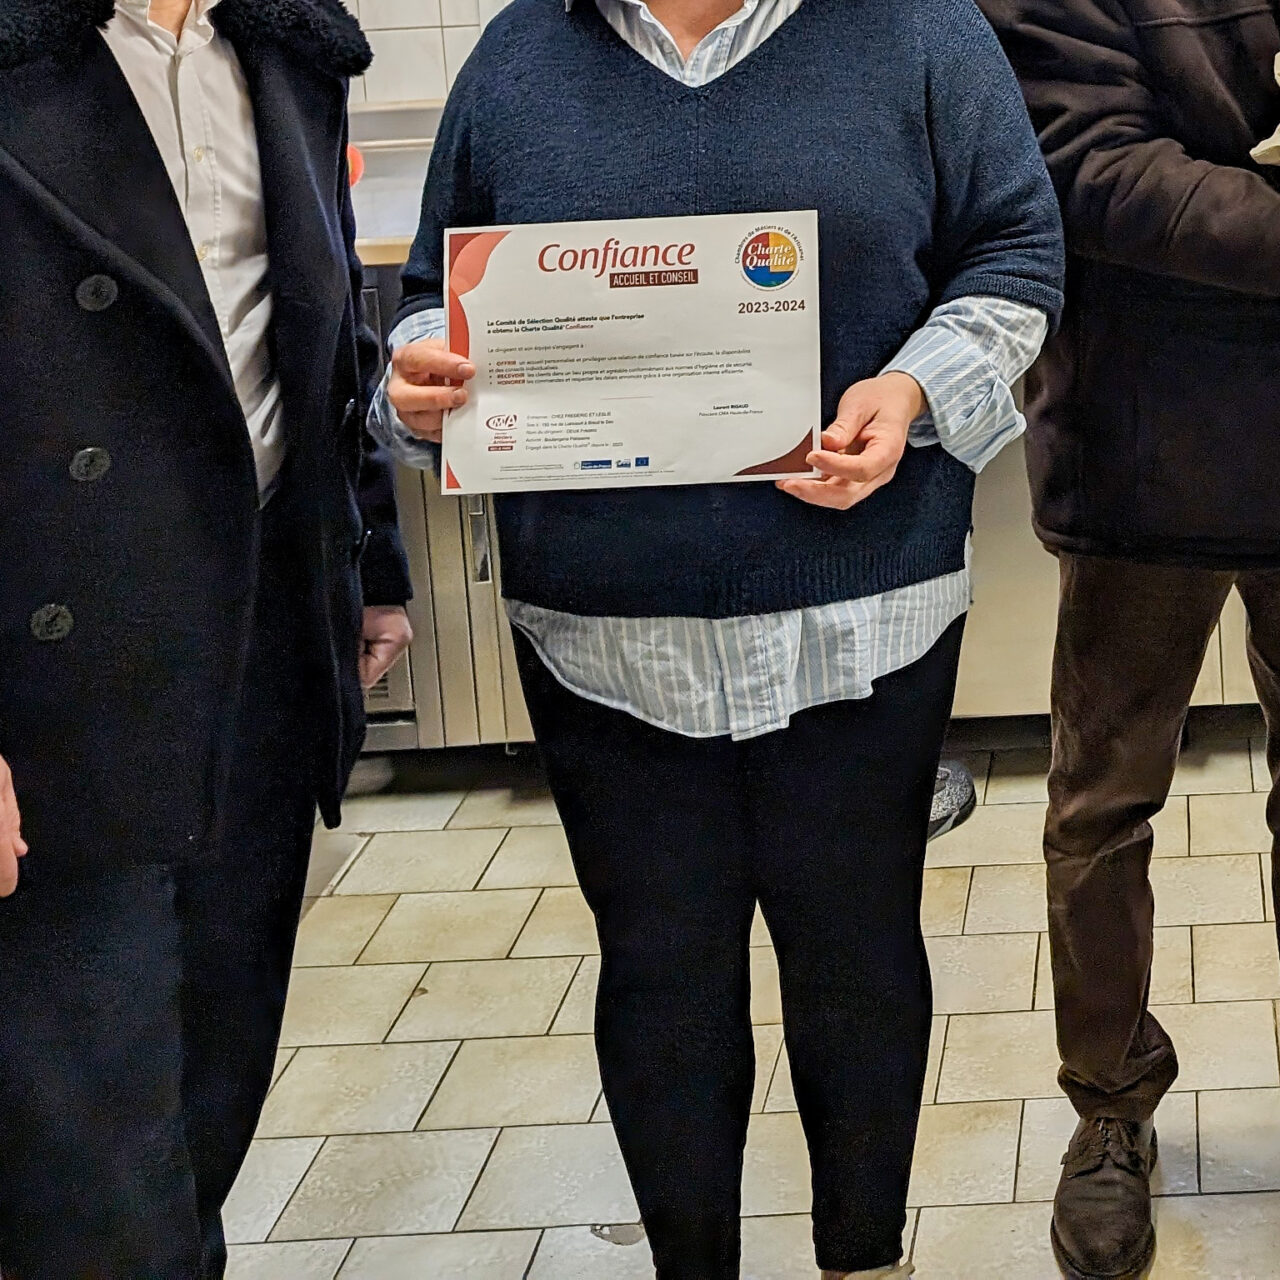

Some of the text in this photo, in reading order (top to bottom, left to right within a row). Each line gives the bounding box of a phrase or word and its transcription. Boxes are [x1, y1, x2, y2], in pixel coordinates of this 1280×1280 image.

[747, 243, 792, 255] Charte
[538, 238, 696, 278] Confiance
[746, 253, 794, 271] Qualité
[613, 272, 696, 286] ACCUEIL ET CONSEIL
[738, 300, 806, 314] 2023-2024
[554, 316, 576, 324] Qualité
